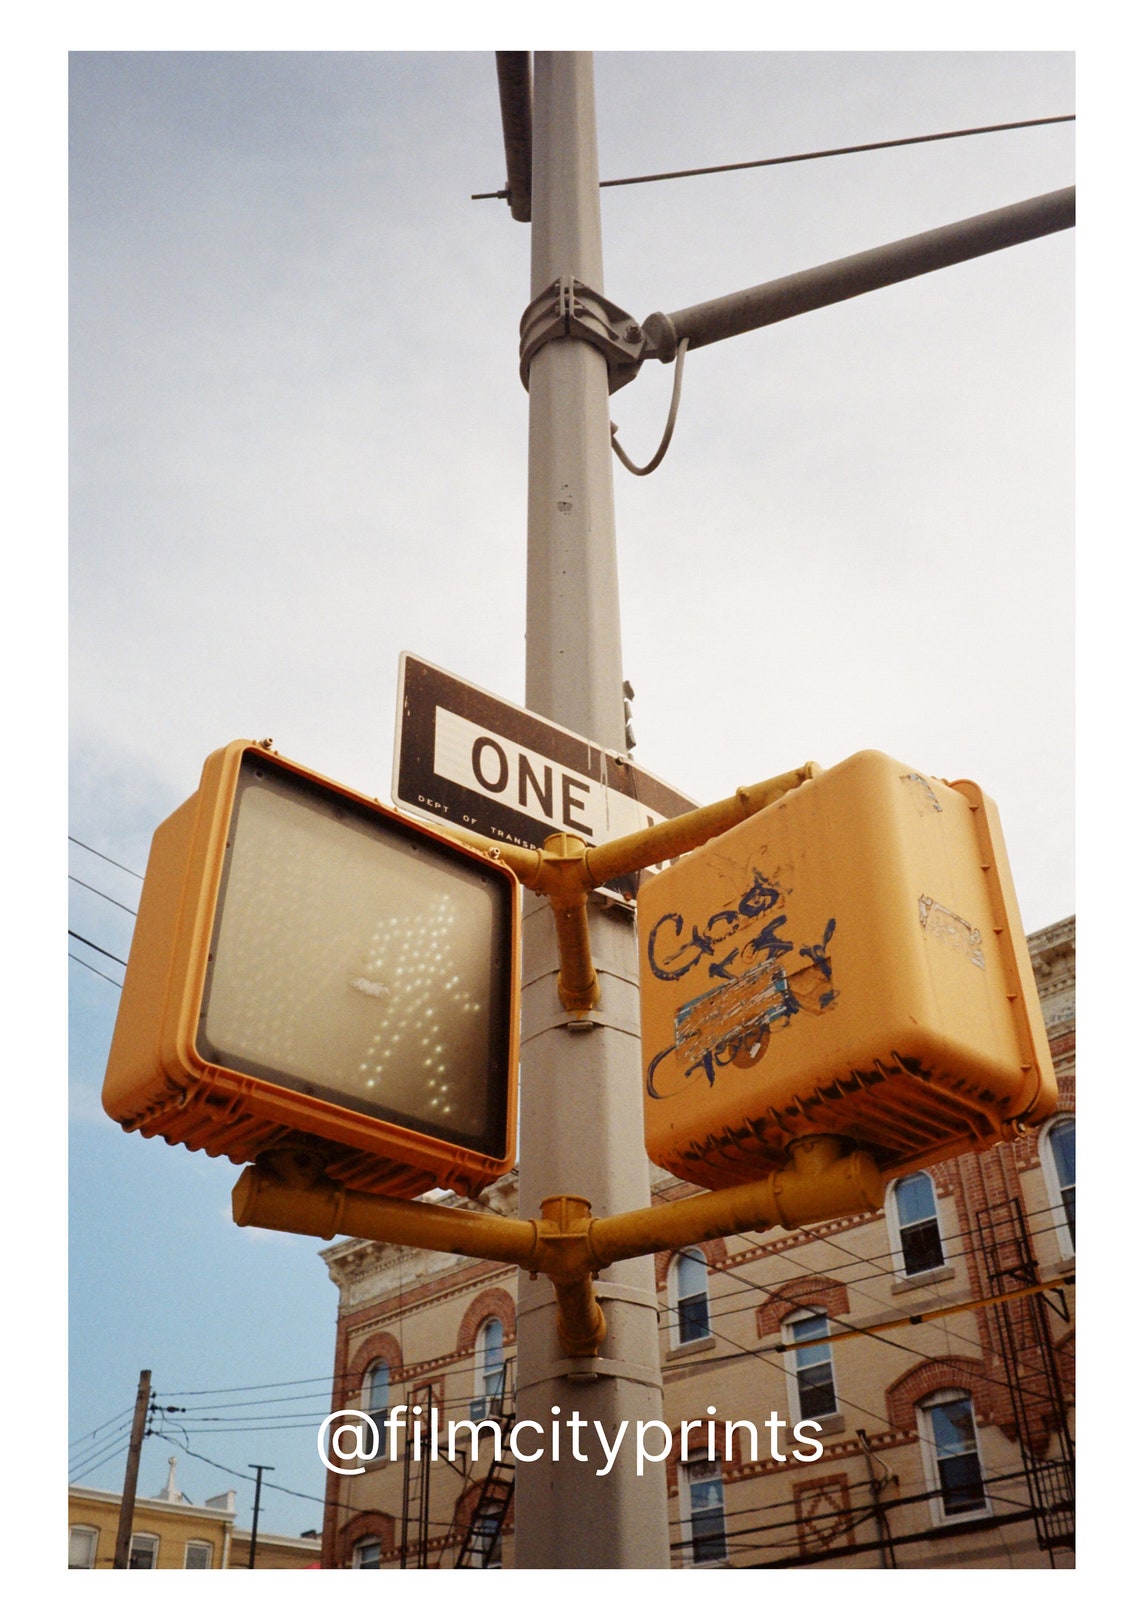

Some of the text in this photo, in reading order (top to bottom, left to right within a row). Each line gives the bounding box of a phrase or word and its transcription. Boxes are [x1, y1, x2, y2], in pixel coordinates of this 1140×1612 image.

[418, 794, 542, 850] DEPT OF TRANSP
[472, 737, 593, 836] ONE
